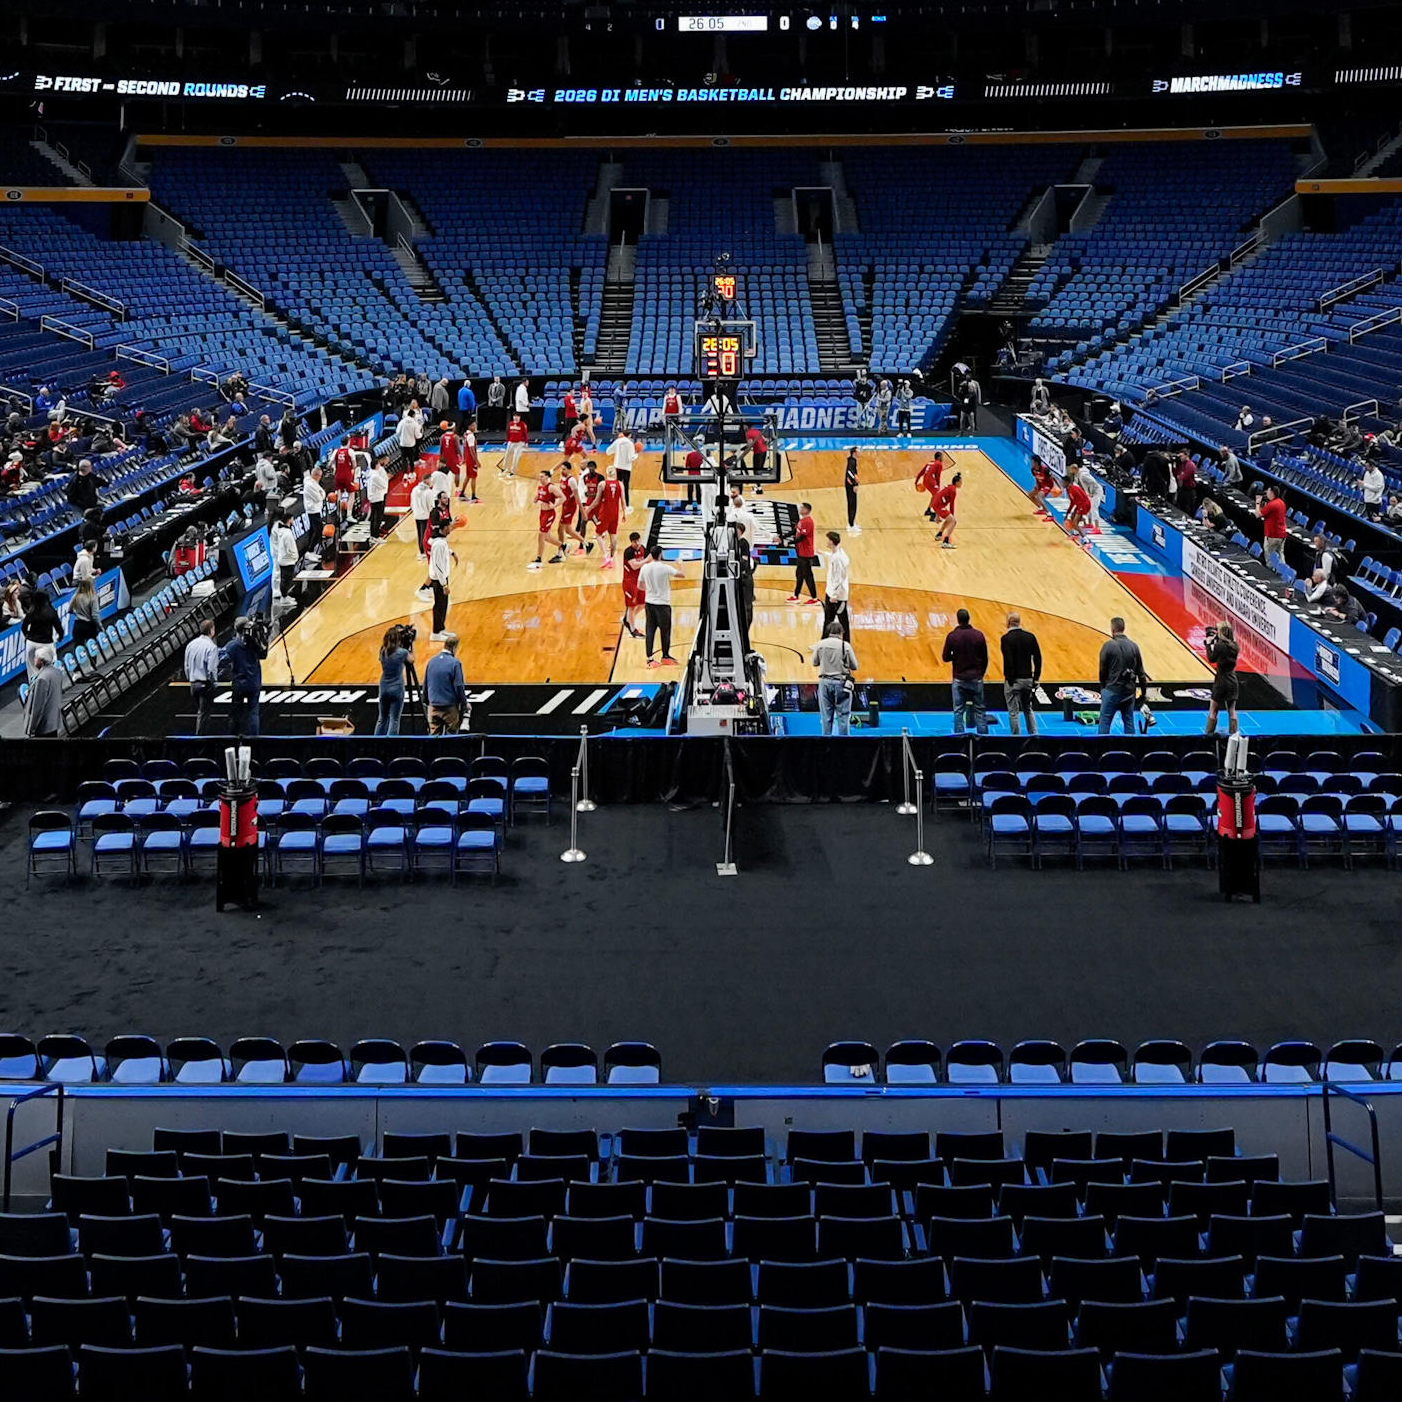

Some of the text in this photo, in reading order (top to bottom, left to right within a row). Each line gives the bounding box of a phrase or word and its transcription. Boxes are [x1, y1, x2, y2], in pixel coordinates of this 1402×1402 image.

[54, 76, 101, 92] FIRST
[117, 80, 180, 95] SECOND
[183, 83, 248, 98] ROUNDS
[554, 86, 907, 102] 2026 DI MEN'S BASKETBALL CHAMPIONSHIP
[715, 277, 735, 286] 26:05
[1226, 588, 1234, 607] AND
[1251, 609, 1276, 640] UNIVERSITY
